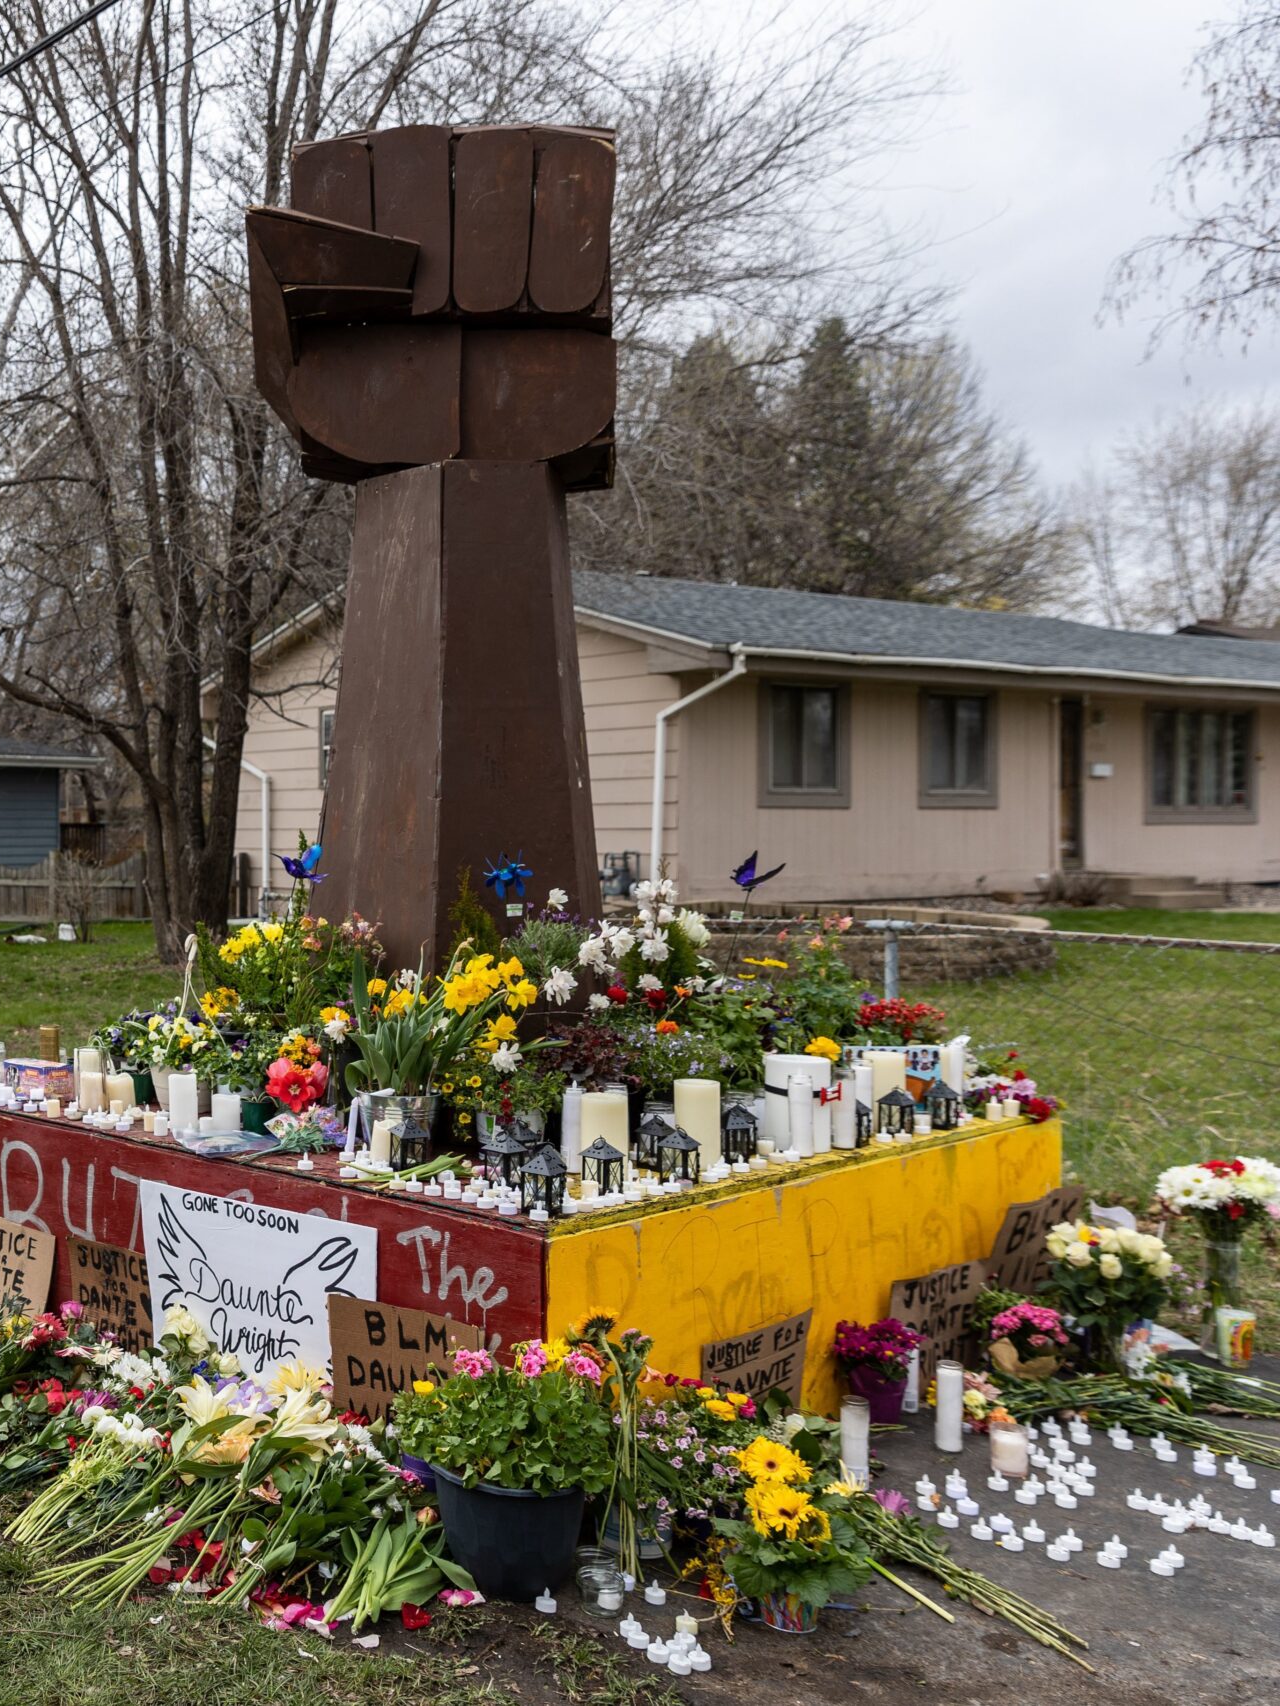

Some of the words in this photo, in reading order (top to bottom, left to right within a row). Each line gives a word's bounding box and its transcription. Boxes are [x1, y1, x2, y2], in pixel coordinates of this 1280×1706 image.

[182, 1192, 219, 1214] GONE
[223, 1200, 255, 1224] TOO
[256, 1209, 300, 1234] SOON
[77, 1244, 150, 1287] JUSTICE
[396, 1225, 509, 1310] The
[903, 1264, 971, 1309] JUSTICE
[79, 1283, 137, 1326] DANTE
[184, 1257, 313, 1325] Daunte
[209, 1307, 300, 1373] Wright
[364, 1309, 449, 1358] BLM
[707, 1334, 764, 1369] JUSTICE
[773, 1320, 804, 1352] FOR
